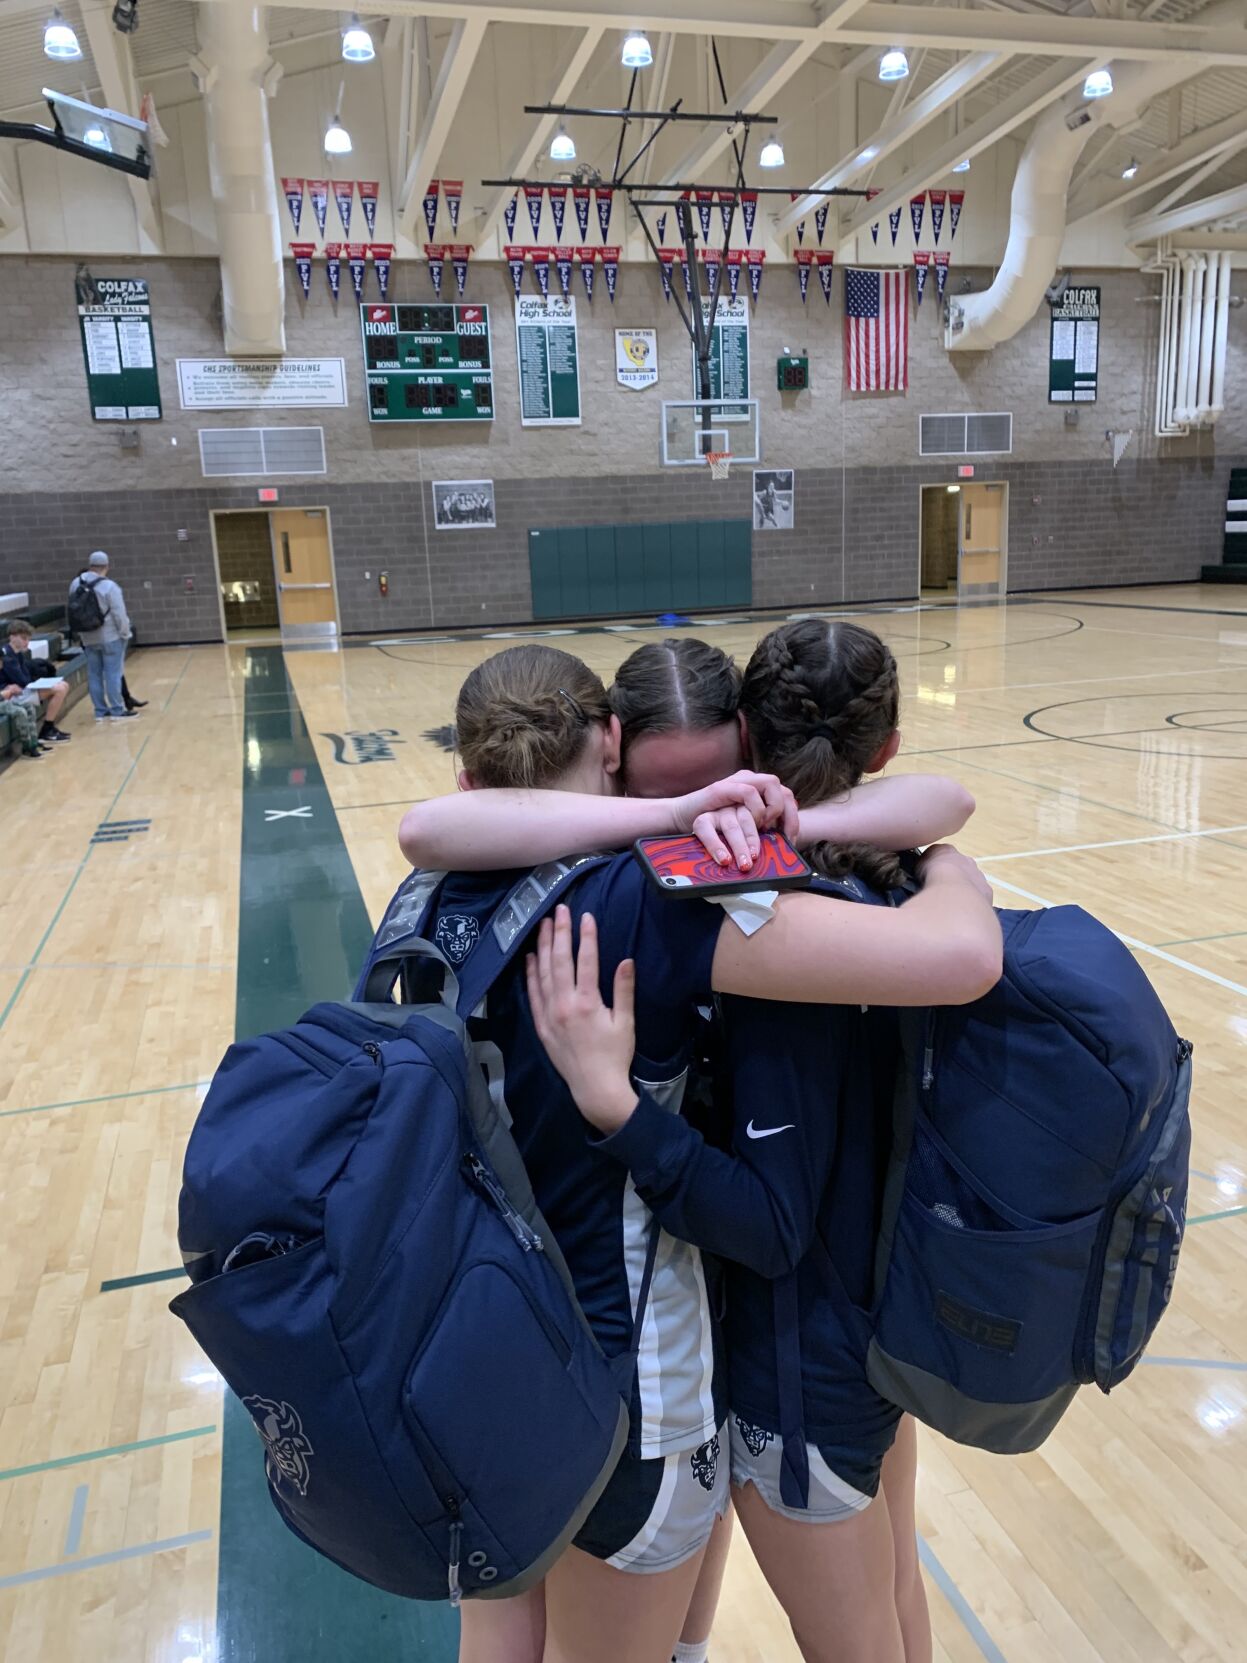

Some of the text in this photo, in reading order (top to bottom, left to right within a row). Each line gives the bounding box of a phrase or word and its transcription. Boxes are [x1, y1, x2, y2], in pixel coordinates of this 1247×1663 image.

[301, 264, 310, 290] PVL
[330, 266, 338, 290] PVL
[354, 266, 362, 291] PVL
[540, 270, 548, 293] PVL
[98, 281, 144, 292] COLFAX
[1064, 290, 1097, 304] COLFAX
[520, 310, 540, 318] High
[366, 322, 397, 335] HOME
[457, 322, 486, 335] GUEST
[218, 364, 278, 373] SPORTSMANSHIP
